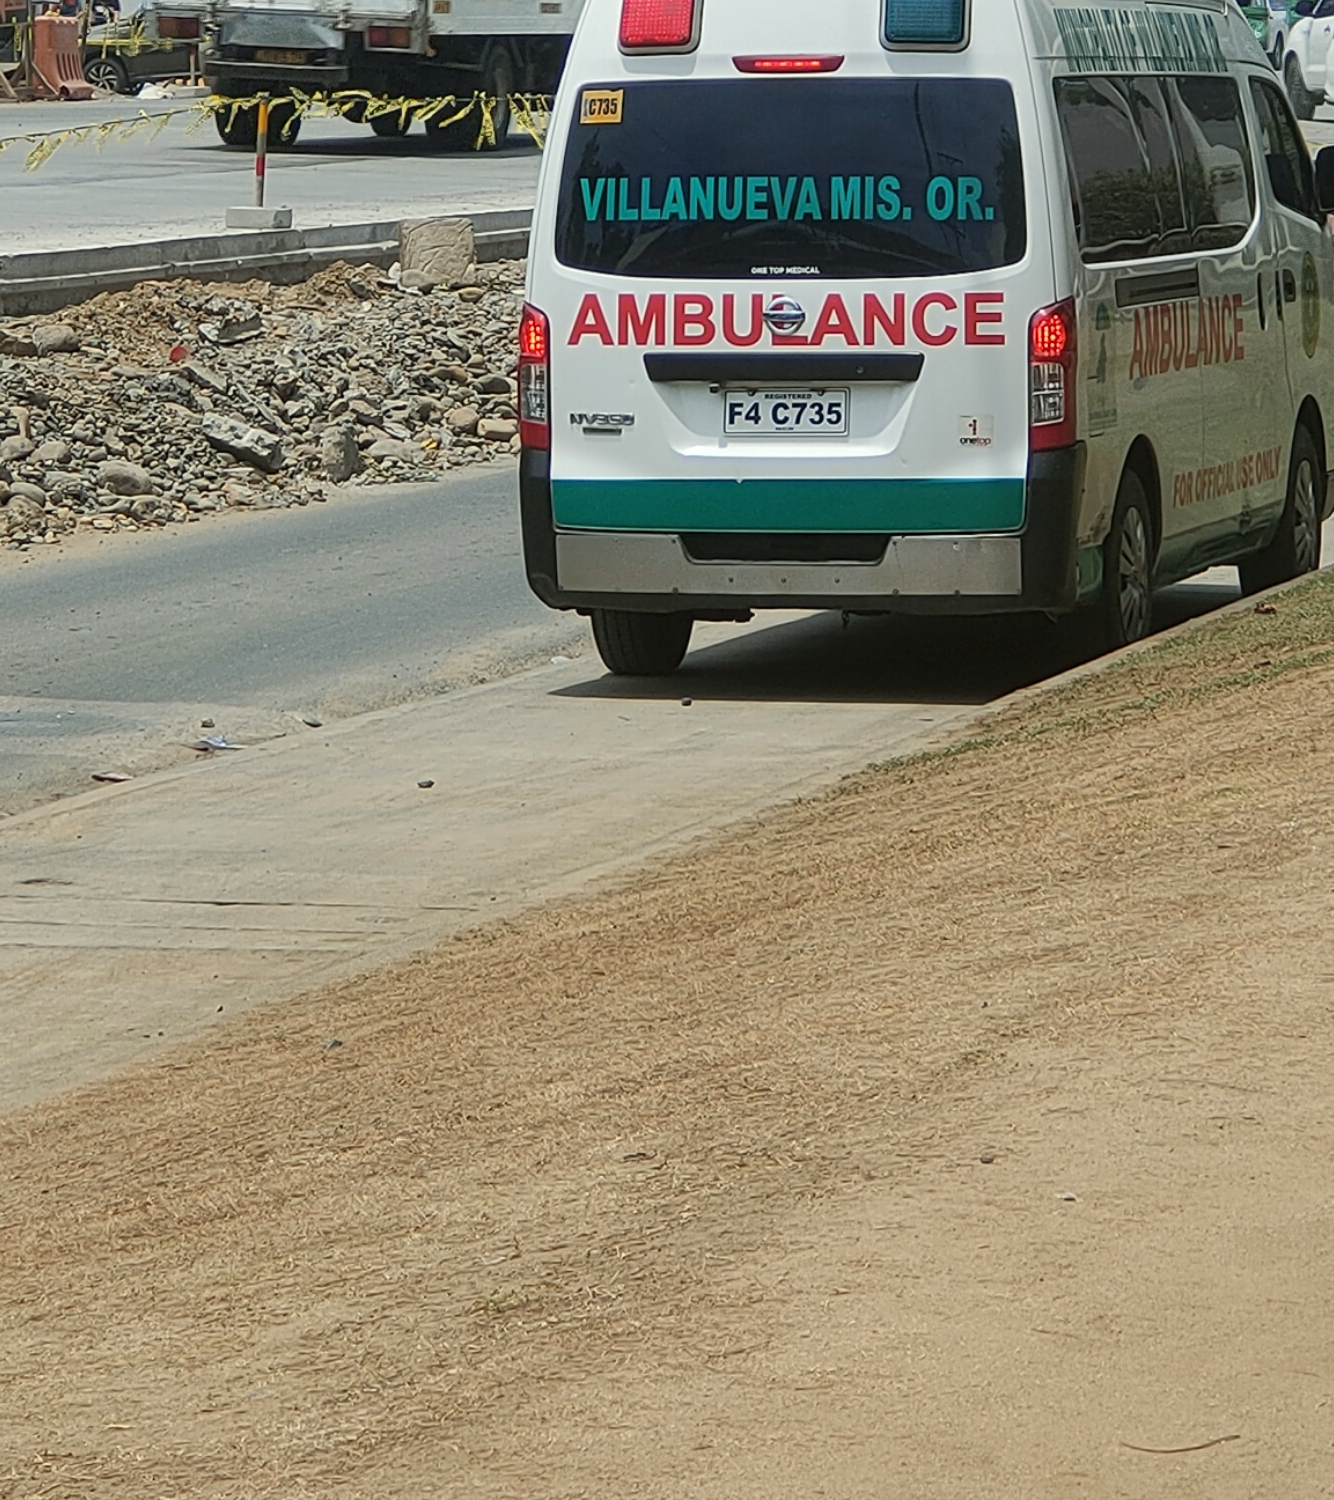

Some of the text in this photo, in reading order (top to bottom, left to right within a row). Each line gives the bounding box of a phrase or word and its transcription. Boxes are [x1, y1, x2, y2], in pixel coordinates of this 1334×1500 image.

[579, 175, 995, 222] VILLANUEVA MIS. OR.
[768, 267, 785, 275] TOP
[786, 267, 820, 275] MEDICAL
[566, 291, 1006, 348] AMBULANCE
[1129, 293, 1245, 380] AMBULANCE
[728, 402, 843, 426] F4 C735
[1173, 470, 1194, 508] FOR
[1195, 460, 1236, 502] OFFICIAL
[1255, 444, 1283, 484] ONLY
